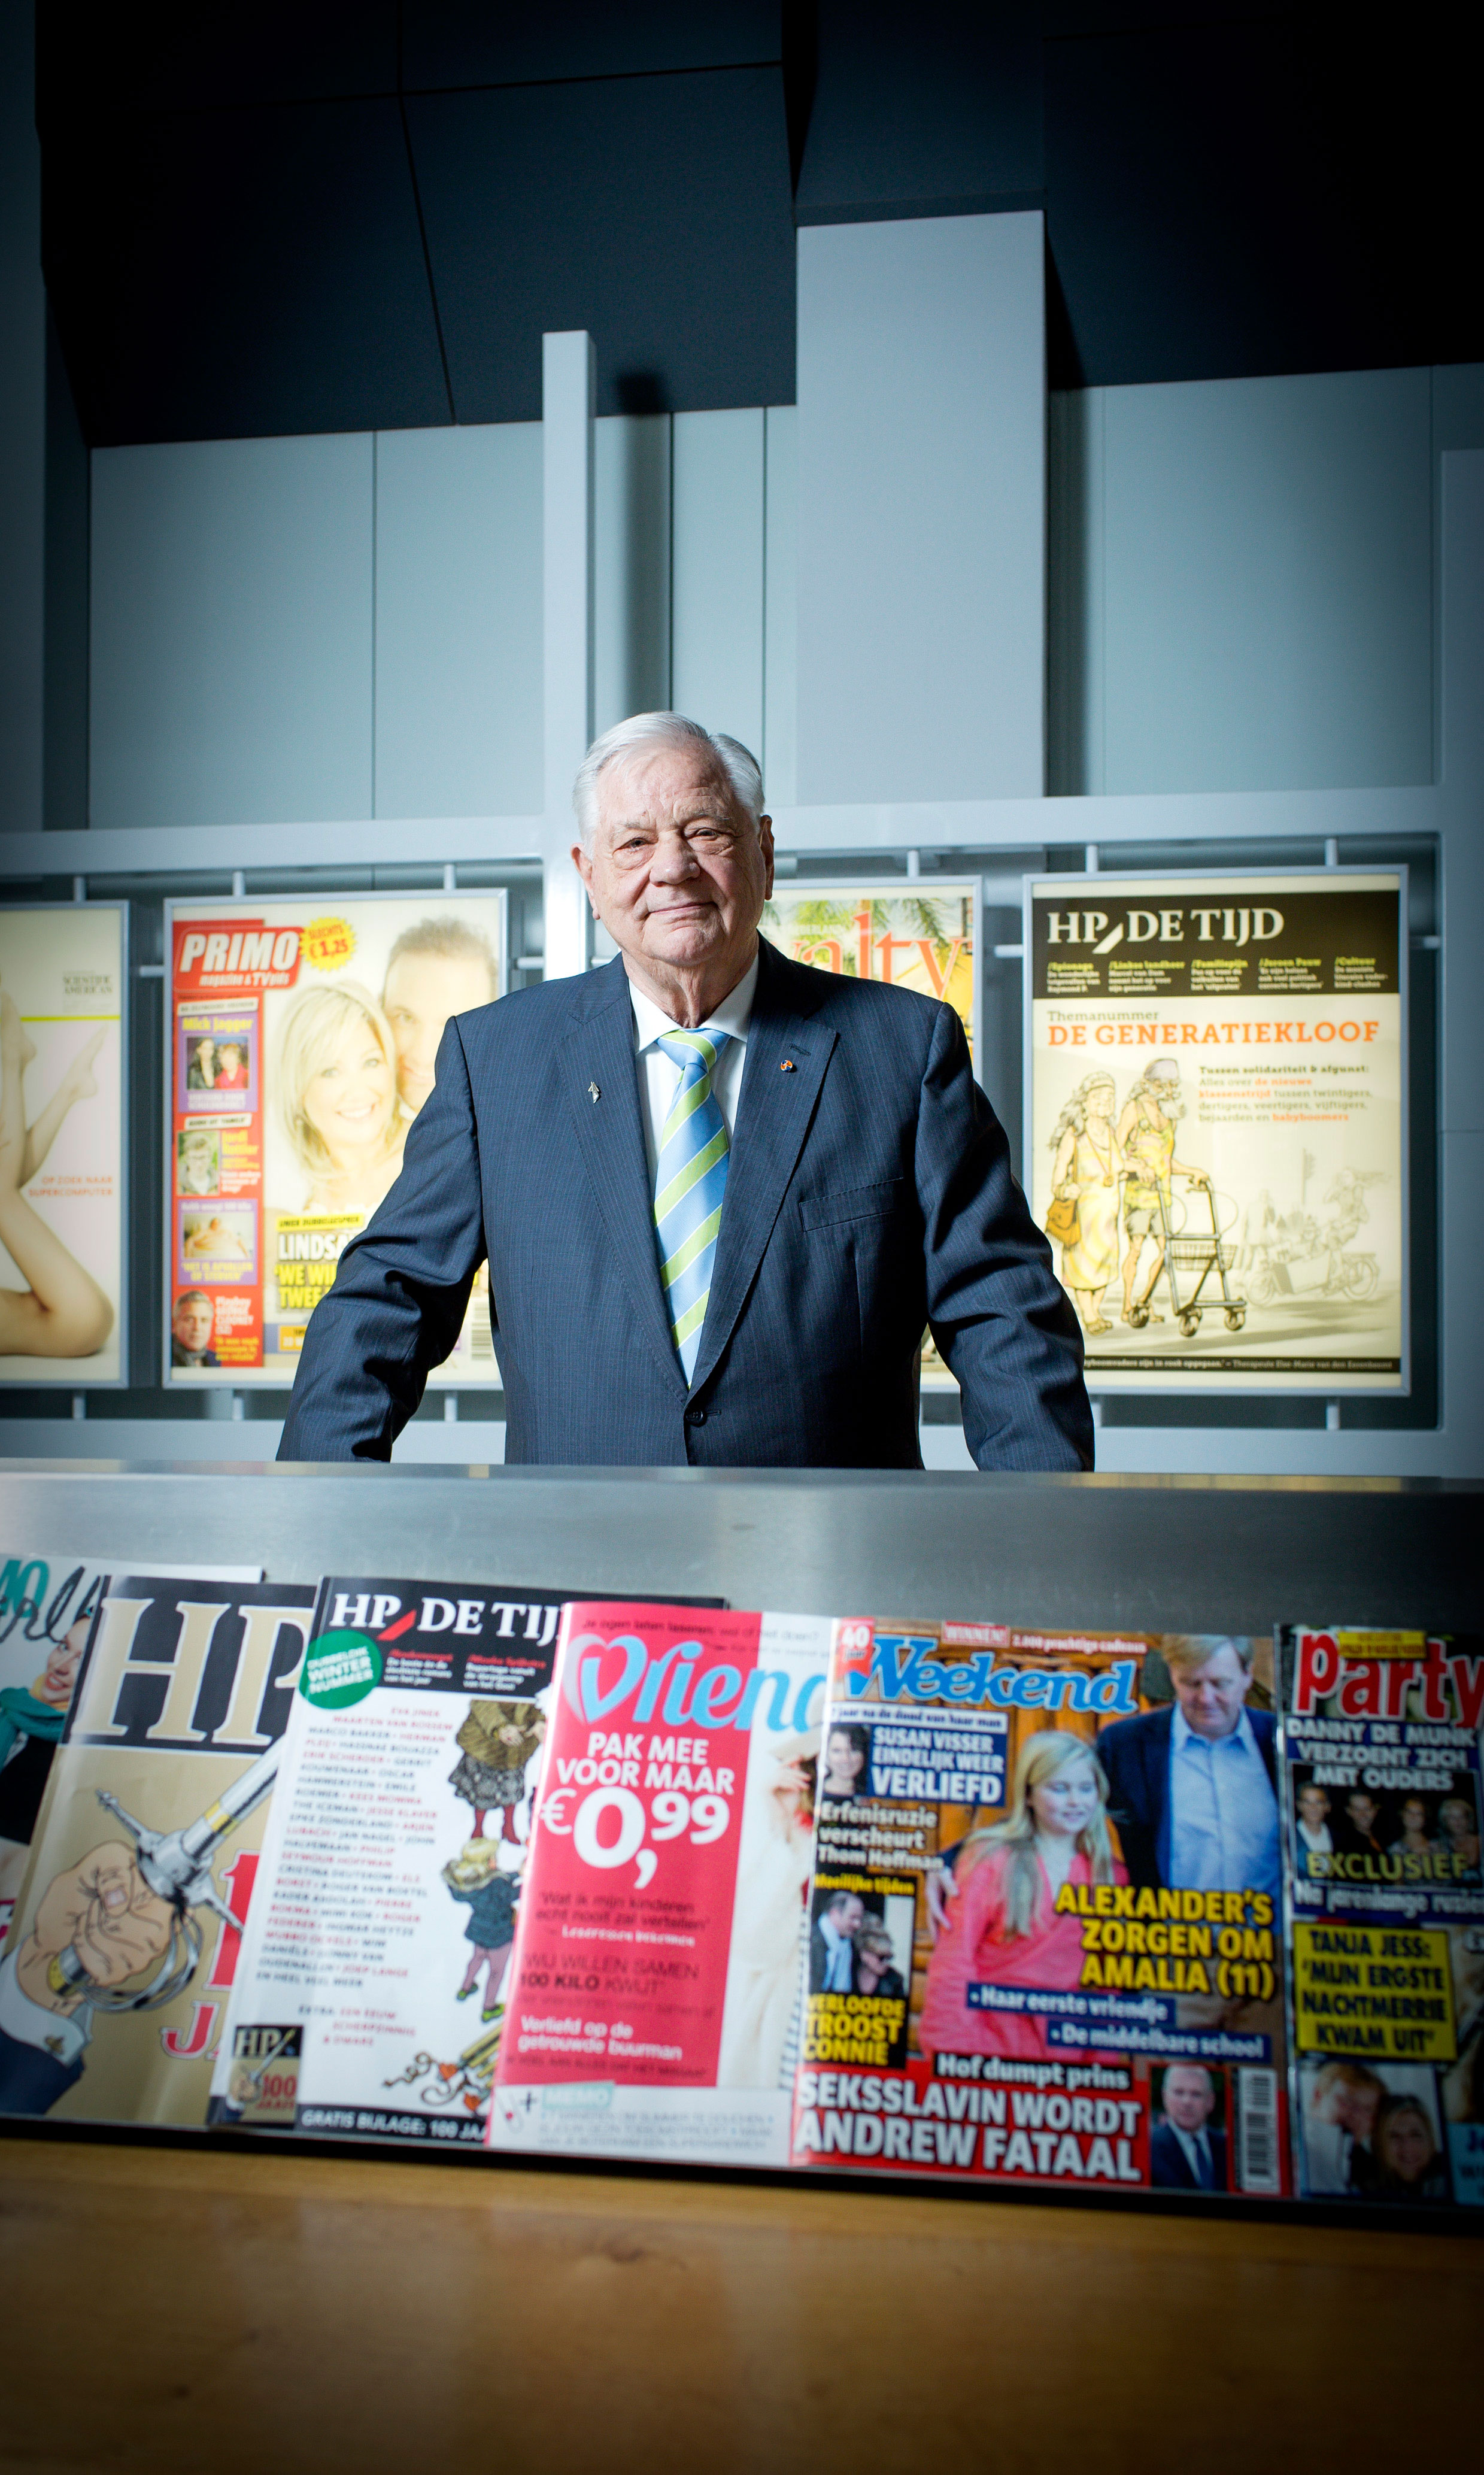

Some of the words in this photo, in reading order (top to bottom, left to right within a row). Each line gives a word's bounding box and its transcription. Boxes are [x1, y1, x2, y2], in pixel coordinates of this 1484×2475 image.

[1190, 907, 1285, 947] TIJD
[181, 932, 299, 972] PRIMO
[63, 975, 110, 985] SCIENTIFIC
[63, 985, 113, 996] AMERICAN
[199, 974, 243, 988] magazine
[183, 1016, 211, 1030] Mick
[1048, 1010, 1158, 1023] Themanummer
[1048, 1026, 1087, 1045] DE
[1095, 1021, 1379, 1045] GENERATIEKLOOF
[1199, 1090, 1270, 1099] klassenstrijd
[1199, 1114, 1252, 1123] bejaarden
[1273, 1113, 1349, 1123] babyboomers
[491, 1602, 561, 1646] TIJ
[842, 1625, 870, 1647] 40
[308, 1656, 371, 1682] WINTER
[845, 1634, 1137, 1713] Weekend
[873, 1727, 931, 1748] SUSAN
[934, 1733, 994, 1753] VISSER
[1287, 1716, 1365, 1742] DANNY
[1370, 1722, 1400, 1744] DE
[1405, 1725, 1476, 1747] MUNK
[587, 1732, 644, 1760] PAK
[648, 1737, 709, 1764] MEE
[872, 1746, 952, 1771] EINDELIJK
[954, 1752, 1004, 1772] WEER
[1297, 1739, 1410, 1766] VERZOENT
[1415, 1748, 1467, 1768] ZICH
[557, 1758, 640, 1787] VOOR
[645, 1764, 735, 1794] MAAR
[871, 1766, 1002, 1803] VERLIEFD
[1313, 1766, 1359, 1787] MET
[1362, 1767, 1453, 1790] OUDERS
[821, 1800, 937, 1828] Erfenisruzie
[818, 1827, 925, 1849] verscheurt
[818, 1845, 866, 1866] Thom
[868, 1849, 944, 1871] Hoffman
[1306, 1852, 1468, 1880] EXCLUSIEF
[1055, 1883, 1273, 1925] ALEXANDER'S
[1081, 1918, 1212, 1958] ZORGEN
[1218, 1926, 1274, 1961] OM
[1310, 1930, 1372, 1956] TANJA
[554, 1973, 599, 1990] KILO
[1081, 1954, 1210, 1993] AMALIA
[1216, 1960, 1274, 2000] (11)
[1368, 1964, 1443, 1989] ERGSTE
[981, 1985, 1024, 2010] Haar
[1027, 1994, 1087, 2015] eerste
[1089, 1996, 1168, 2024] vriendje
[1302, 1991, 1444, 2022] NACHTMERRIE
[521, 2015, 581, 2035] Verliefd
[584, 2021, 608, 2038] op
[610, 2021, 633, 2039] de
[808, 2013, 903, 2043] TROOST
[1318, 2024, 1385, 2049] KWAM
[518, 2034, 605, 2054] getrouwde
[608, 2038, 682, 2061] buurman
[805, 2039, 889, 2065] CONNIE
[1061, 2024, 1088, 2045] De
[1090, 2026, 1198, 2054] middelbare
[1200, 2036, 1264, 2058] school
[938, 2055, 984, 2077] Hof
[985, 2059, 1062, 2090] dumpt
[1066, 2066, 1130, 2090] prins
[799, 2072, 1006, 2126] SEKSSLAVIN
[1012, 2091, 1142, 2137] WORDT
[302, 2110, 354, 2127] GRATIS
[430, 2121, 458, 2138] 100
[793, 2110, 978, 2168] ANDREW
[982, 2127, 1142, 2181] FATAAL
